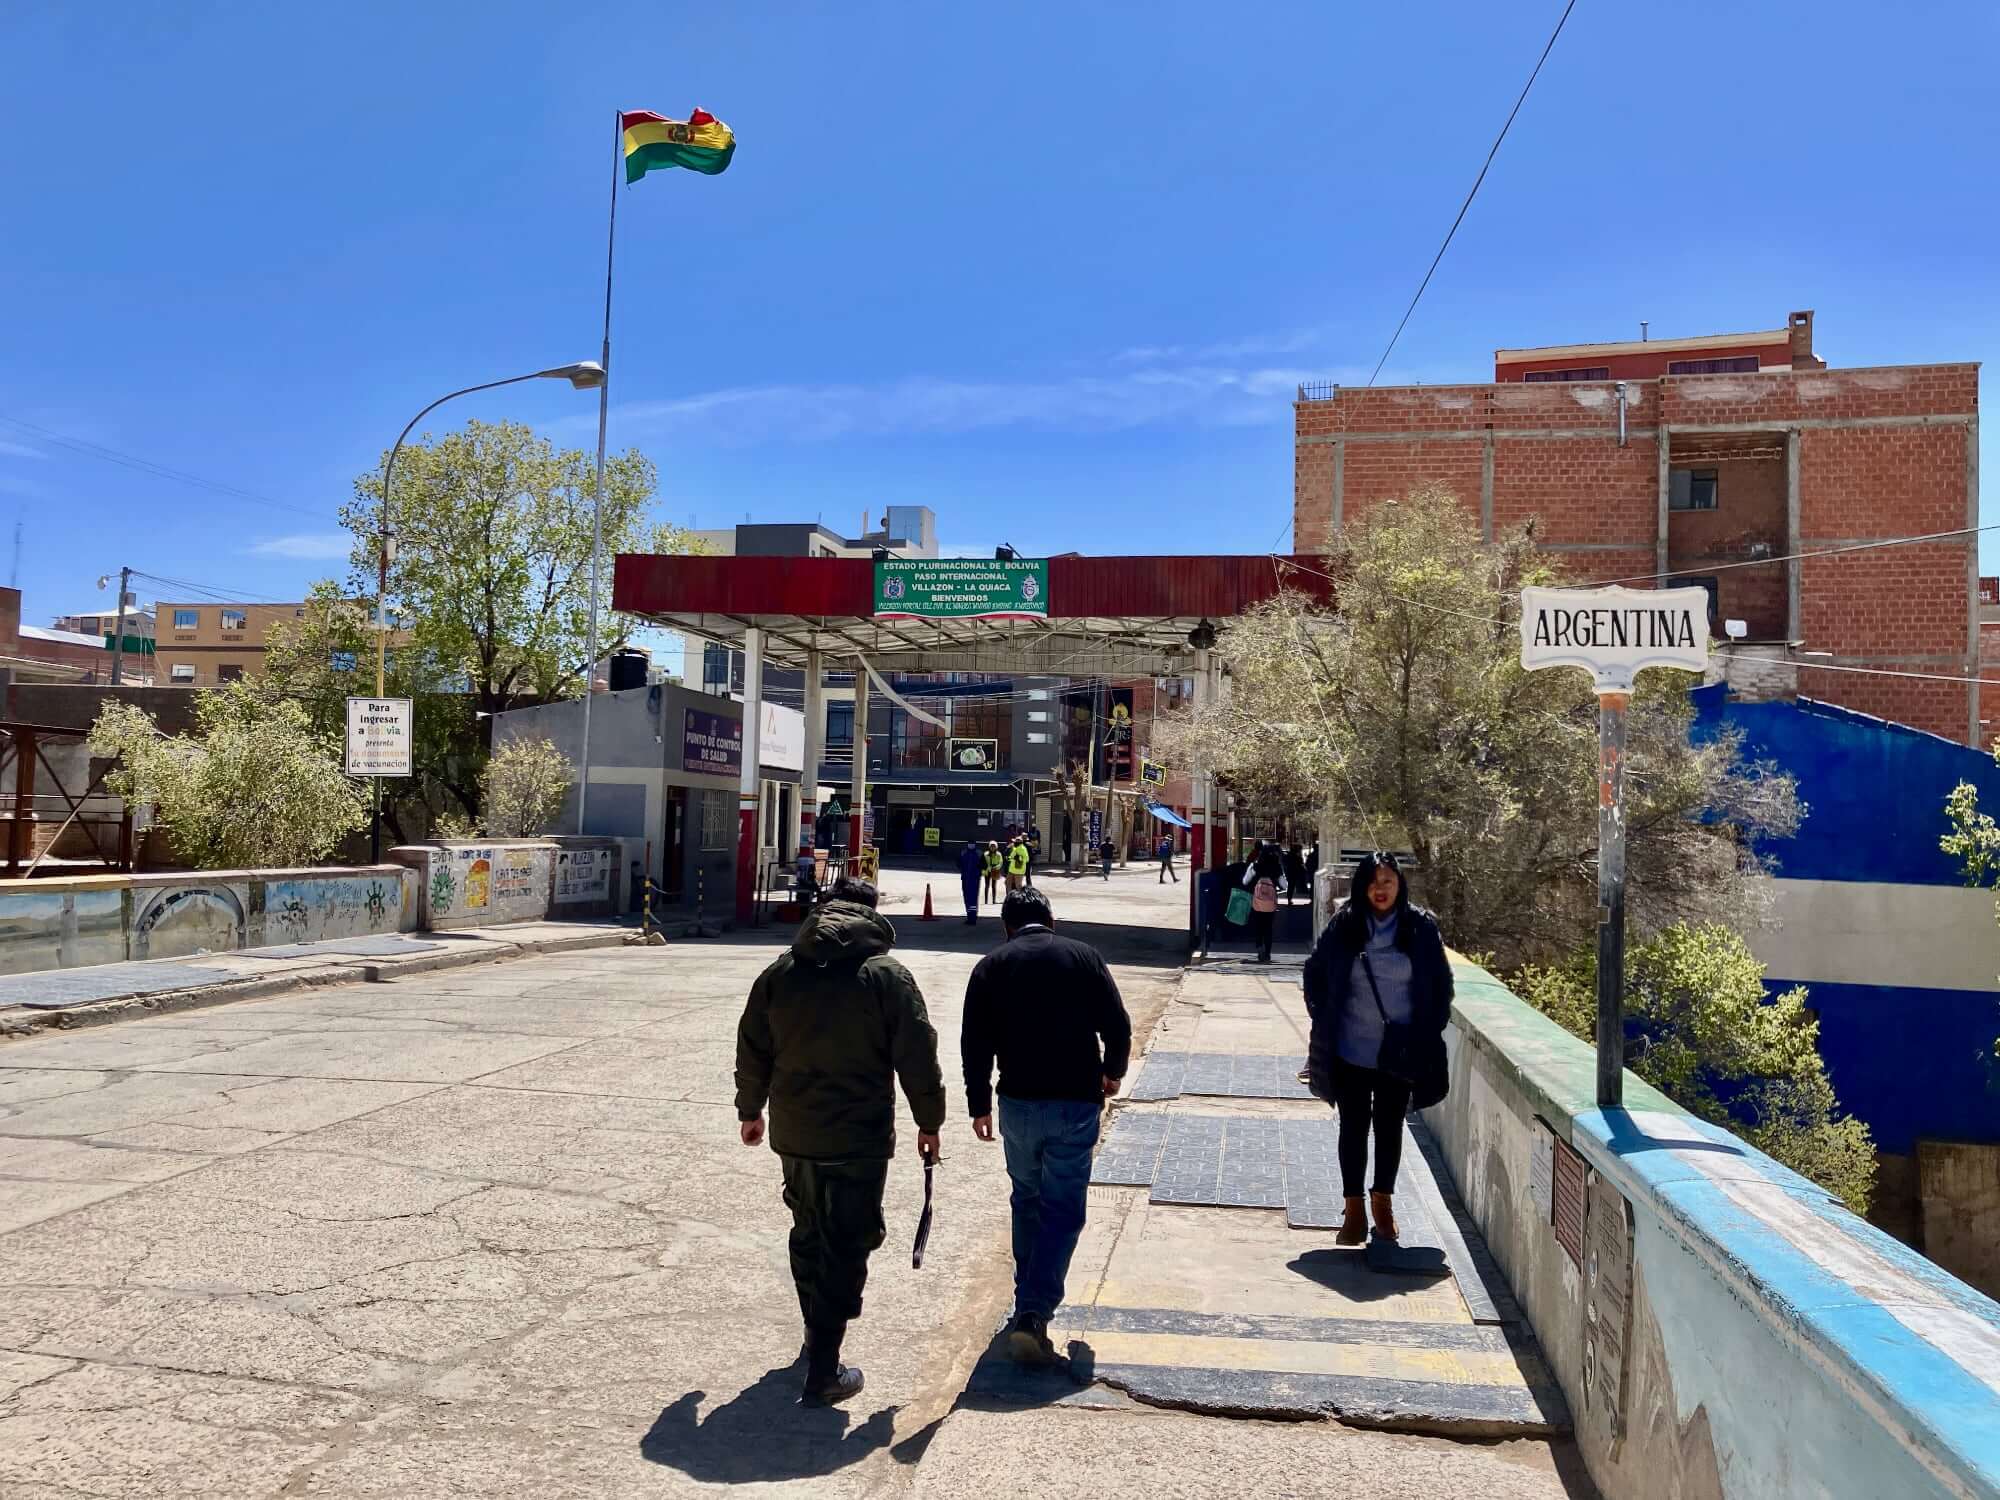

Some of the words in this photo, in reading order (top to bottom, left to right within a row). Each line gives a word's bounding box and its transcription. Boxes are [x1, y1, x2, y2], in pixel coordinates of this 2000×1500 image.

[883, 562, 917, 570] ESTADO
[918, 562, 987, 570] PLURINACIONAL
[991, 562, 1001, 570] DE
[1005, 562, 1040, 570] BOLIVIA
[914, 573, 937, 581] PASO
[939, 573, 1007, 581] INTERNACIONAL
[911, 583, 954, 591] VILLAZON
[964, 583, 976, 591] LA
[979, 583, 1011, 591] QUIACA
[931, 594, 988, 602] BIENVENIDOS
[1533, 609, 1696, 648] ARGENTINA
[368, 703, 390, 712] Para
[686, 732, 707, 746] PUNTO
[707, 736, 716, 745] DE
[716, 738, 741, 752] CONTROL
[701, 748, 709, 760] DE
[709, 750, 728, 762] SALUD
[351, 760, 361, 768] de
